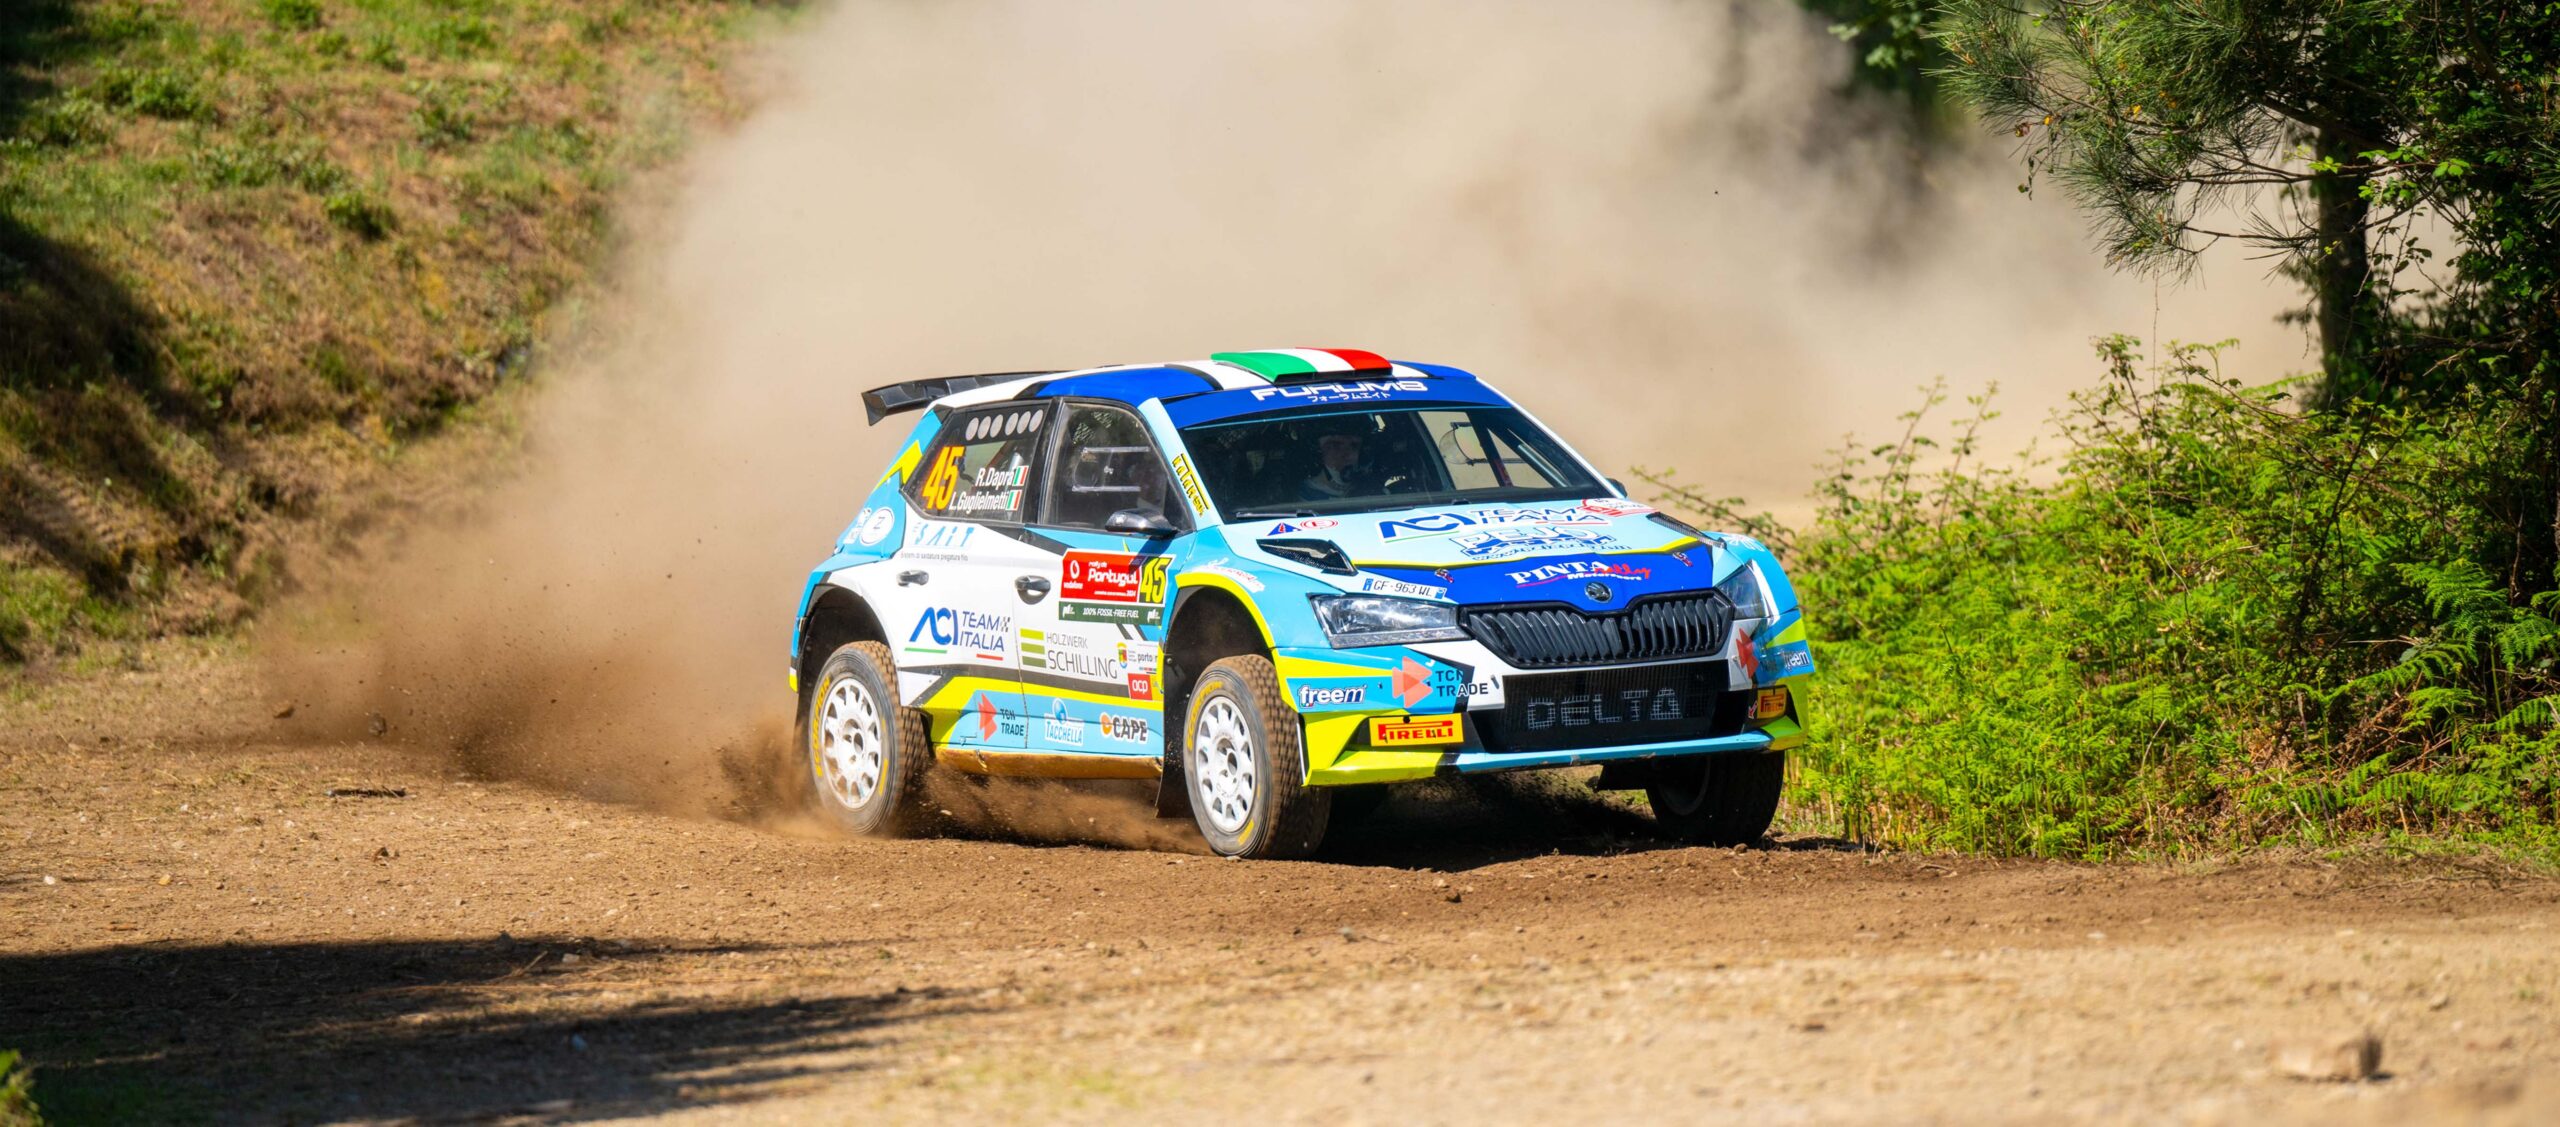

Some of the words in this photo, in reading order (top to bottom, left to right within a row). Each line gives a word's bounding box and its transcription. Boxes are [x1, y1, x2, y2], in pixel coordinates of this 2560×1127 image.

[922, 446, 965, 511] 45
[1470, 508, 1578, 518] TEAM
[1483, 515, 1605, 525] ITALIA
[1140, 558, 1172, 603] 45
[1505, 561, 1610, 584] PINTA
[1395, 584, 1416, 594] 963
[909, 606, 958, 646] ACI
[962, 611, 1000, 631] TEAM
[959, 631, 1005, 652] ITALIA
[1046, 632, 1088, 649] HOLZWERK
[1047, 649, 1118, 679] SCHILLING
[1299, 684, 1366, 707] freem
[1436, 683, 1489, 697] TRADE
[1527, 688, 1684, 730] DELTA
[1001, 722, 1025, 737] TRADE
[1046, 721, 1083, 744] TACCHELLA
[1112, 716, 1148, 742] CAPE
[1377, 720, 1454, 741] PIRELLI
